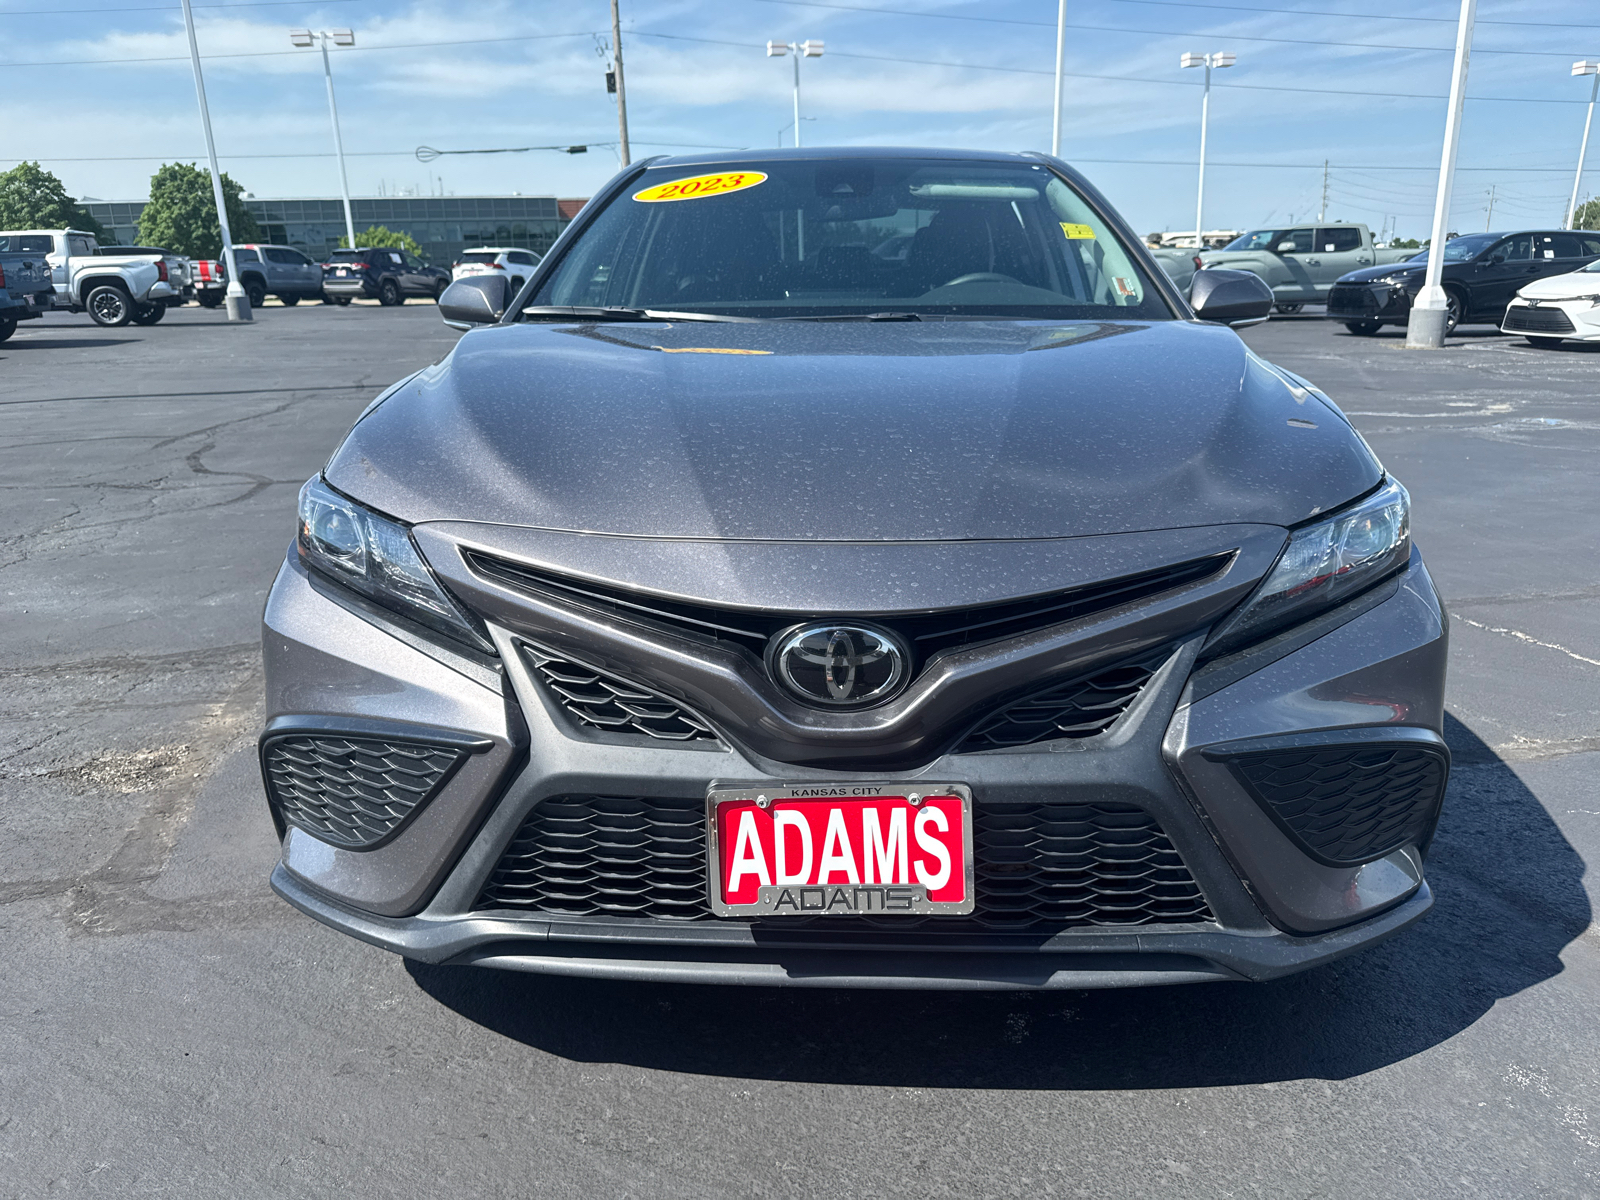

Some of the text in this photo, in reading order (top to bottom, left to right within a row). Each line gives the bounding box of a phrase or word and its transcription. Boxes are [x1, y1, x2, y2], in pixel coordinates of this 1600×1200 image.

[656, 175, 745, 199] 2023
[791, 787, 882, 797] KANSAS CITY
[727, 806, 951, 893] ADAMS
[773, 888, 912, 911] ADAMS
